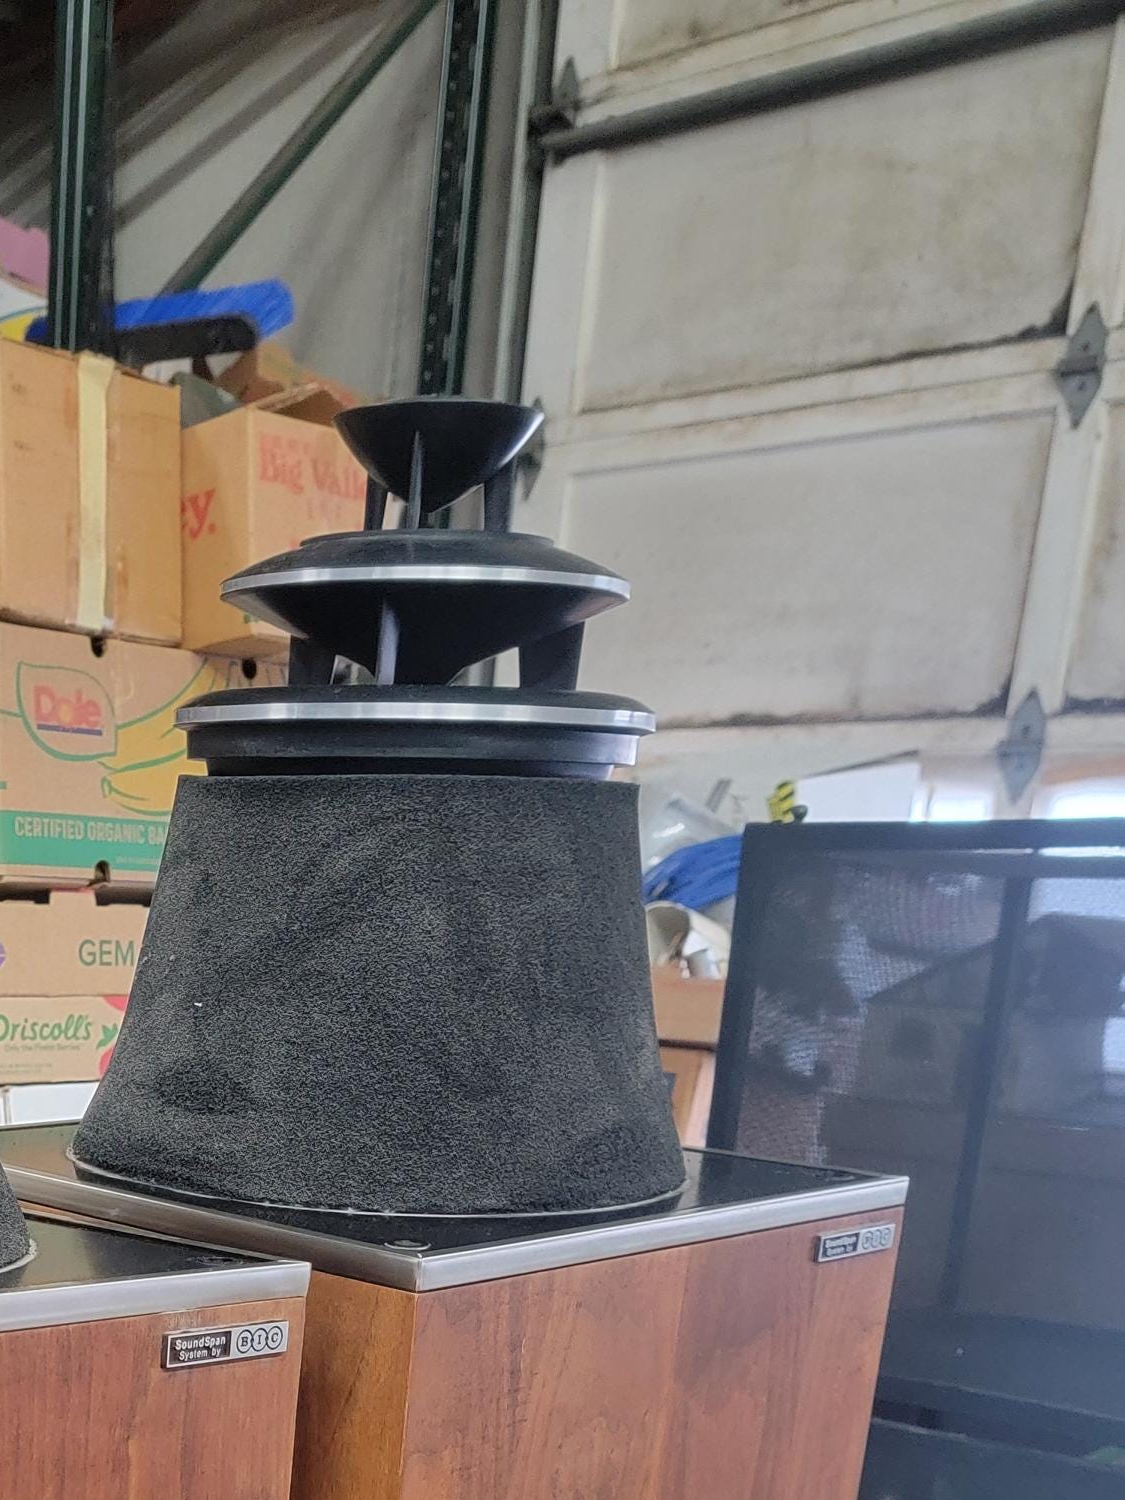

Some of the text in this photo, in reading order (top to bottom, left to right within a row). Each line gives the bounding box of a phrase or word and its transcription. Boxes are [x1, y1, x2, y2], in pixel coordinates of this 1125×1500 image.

[33, 684, 102, 729] Dole
[14, 816, 84, 841] CERTIFIED
[87, 820, 146, 844] ORGANIC
[77, 939, 135, 967] GEM
[175, 1335, 226, 1351] SoundSpan
[179, 1347, 222, 1361] System by
